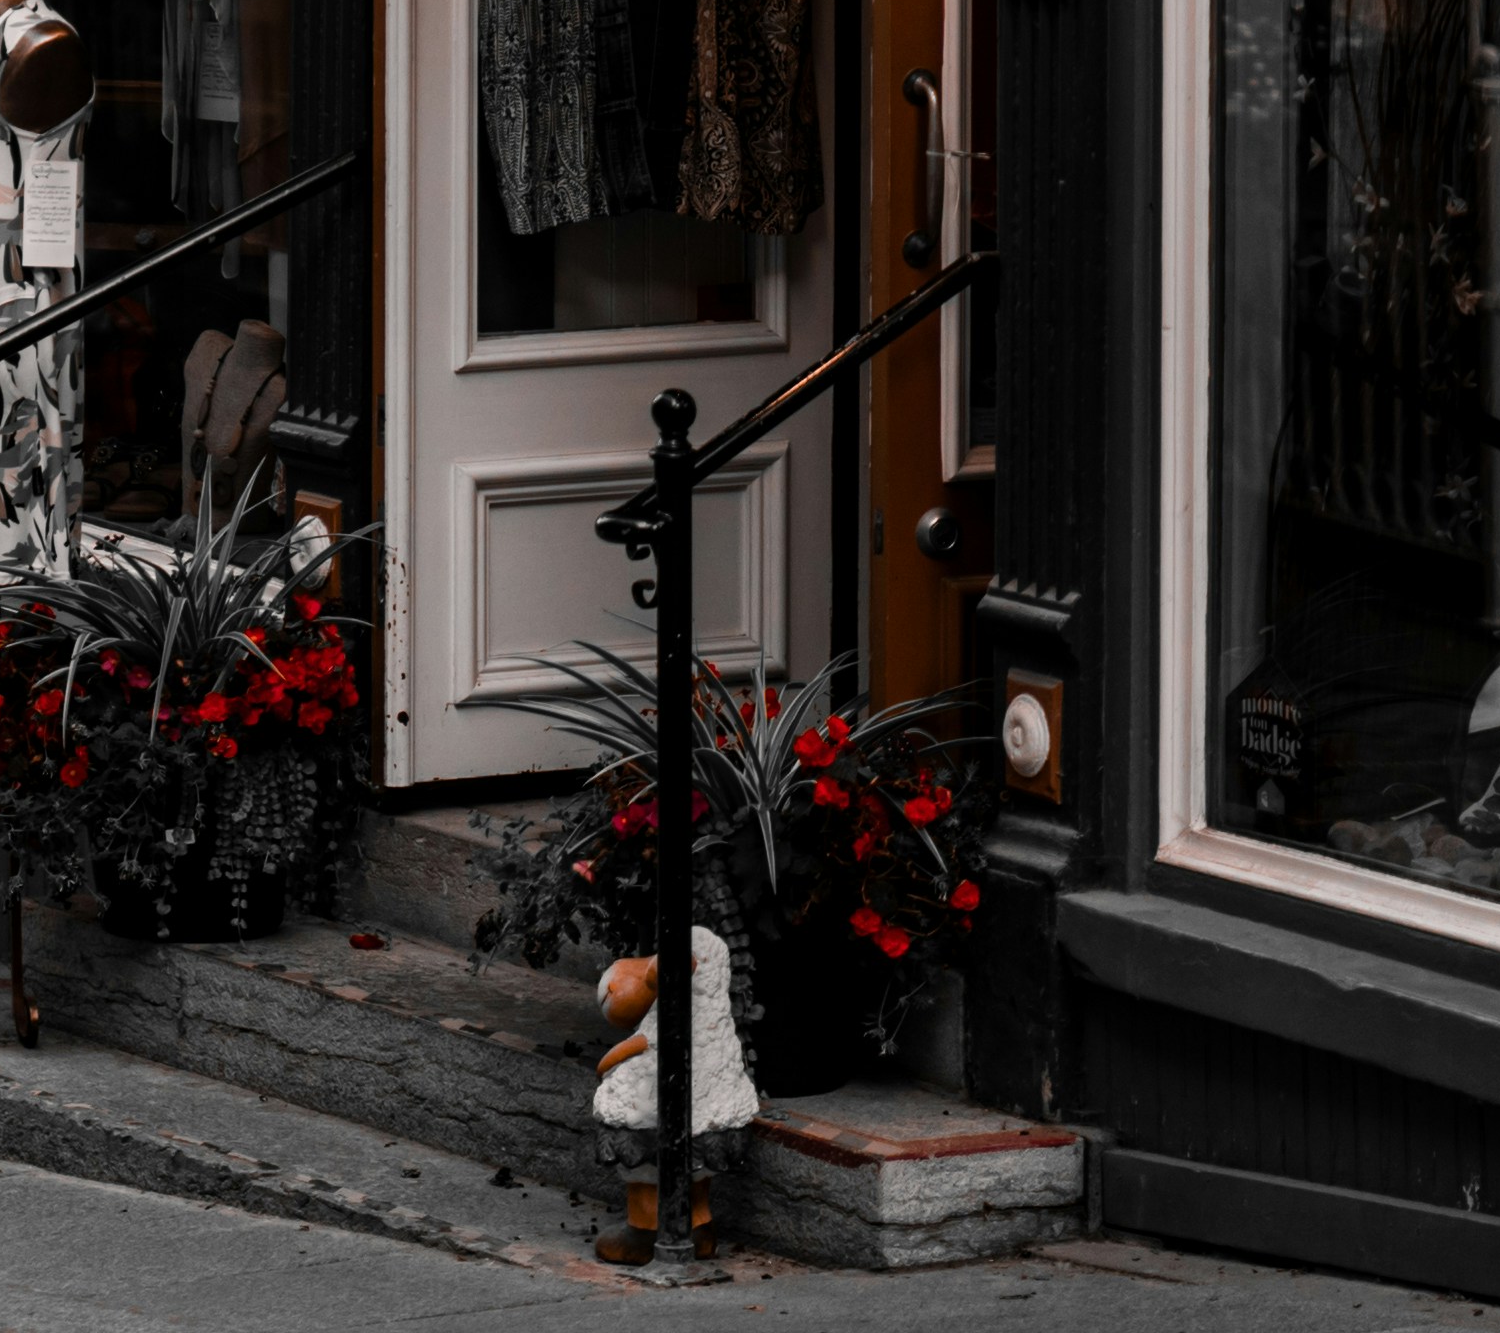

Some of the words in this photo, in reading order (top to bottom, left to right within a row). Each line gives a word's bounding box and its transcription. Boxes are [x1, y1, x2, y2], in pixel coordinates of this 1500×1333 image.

[1241, 696, 1303, 726] montre
[1249, 715, 1268, 731] ton
[1241, 716, 1304, 766] badge
